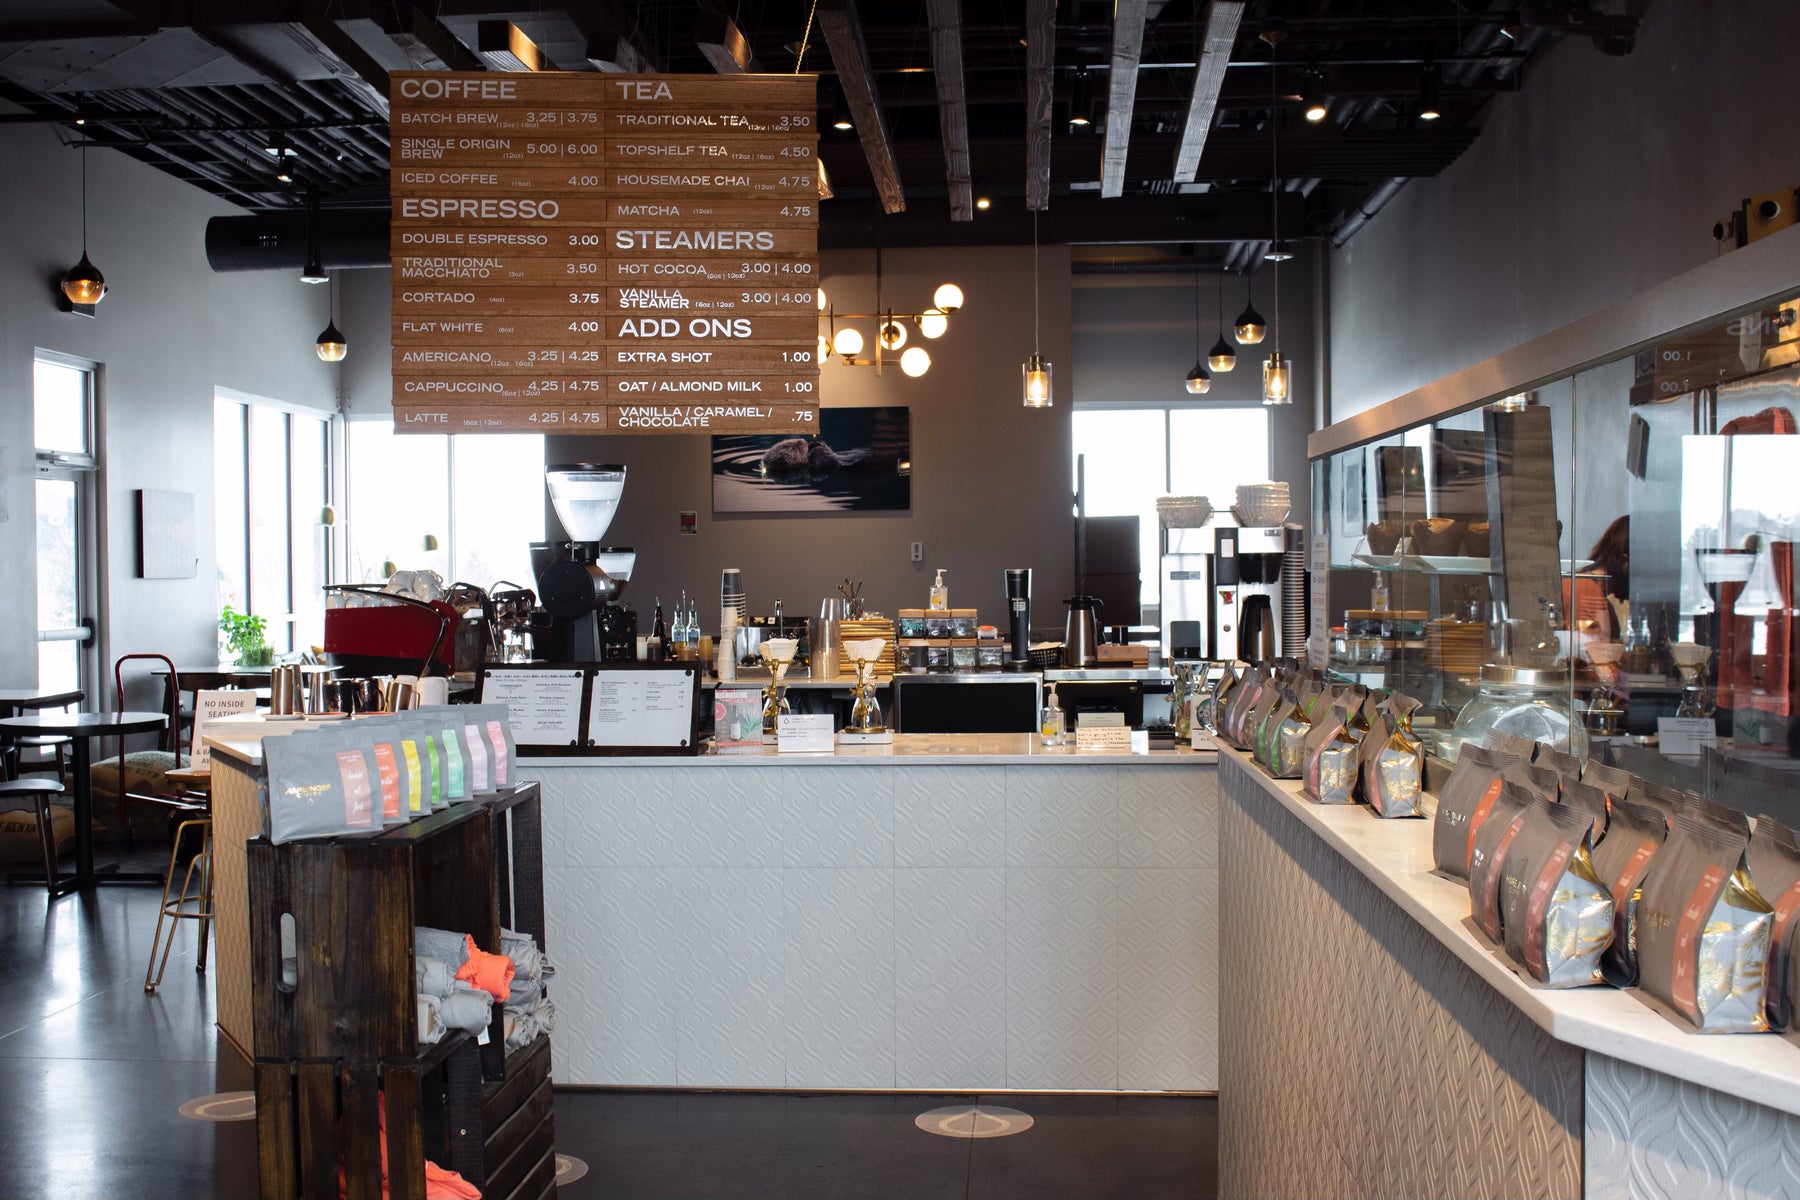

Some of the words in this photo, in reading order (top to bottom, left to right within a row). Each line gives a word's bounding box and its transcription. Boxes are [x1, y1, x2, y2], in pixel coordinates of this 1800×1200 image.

[400, 79, 517, 99] COFFEE
[616, 82, 673, 100] TEA
[402, 114, 451, 123] BATCH
[457, 114, 498, 123] BREW
[526, 112, 556, 123] 3.25
[568, 112, 597, 123] 3.75
[616, 115, 716, 126] TRADITIONAL
[720, 115, 748, 126] TEA
[780, 116, 810, 126] 3.50
[402, 139, 454, 149] SINGLE
[459, 139, 510, 149] ORIGIN
[402, 150, 443, 159] BREW
[527, 144, 556, 154] 5.00
[568, 144, 597, 154] 6.00
[617, 146, 694, 156] TOPSHELF
[699, 146, 728, 156] TEA
[780, 147, 810, 157] 4.50
[402, 174, 435, 183] ICED
[440, 174, 497, 184] COFFEE
[568, 176, 598, 185] 4.00
[617, 175, 710, 185] HOUSEMADE
[715, 176, 749, 186] CHAI
[778, 177, 810, 186] 4.75
[402, 199, 559, 218] ESPRESSO
[618, 206, 679, 216] MATCHA
[780, 207, 810, 216] 4.75
[403, 234, 464, 244] DOUBLE
[469, 234, 548, 245] ESPRESSO
[568, 235, 598, 245] 3.00
[616, 230, 774, 250] STEAMERS
[403, 258, 503, 268] TRADITIONAL
[567, 263, 596, 273] 3.50
[619, 264, 649, 274] HOT
[654, 264, 707, 274] COCOA
[742, 263, 770, 273] 3.00
[782, 263, 811, 273] 4.00
[402, 268, 489, 278] MACCHIATO
[403, 293, 475, 303] CORTADO
[569, 294, 599, 303] 3.75
[619, 288, 682, 299] VANILLA
[742, 292, 770, 303] 3.00
[782, 293, 811, 303] 4.00
[619, 299, 689, 308] STEAMER
[403, 323, 436, 332] FLAT
[440, 323, 483, 332] WHITE
[568, 322, 598, 332] 4.00
[618, 319, 680, 337] ADD
[689, 319, 752, 338] ONS
[402, 352, 491, 362] AMERICANO
[528, 351, 558, 361] 3.25
[569, 351, 598, 361] 4.25
[618, 352, 667, 362] EXTRA
[672, 353, 712, 362] SHOT
[783, 352, 810, 362] 1.00
[405, 382, 503, 392] CAPPUCCINO
[528, 381, 558, 391] 4.25
[569, 381, 599, 391] 4.75
[618, 382, 648, 392] OAT
[660, 382, 723, 391] ALMOND
[727, 382, 761, 391] MILK
[785, 382, 812, 392] 1.00
[406, 414, 448, 423] LATTE
[529, 412, 558, 423] 4.25
[569, 413, 600, 423] 4.75
[619, 407, 682, 416] VANILLA
[694, 407, 764, 417] CARAMEL
[792, 411, 812, 421] .75
[618, 417, 709, 427] CHOCOLATE
